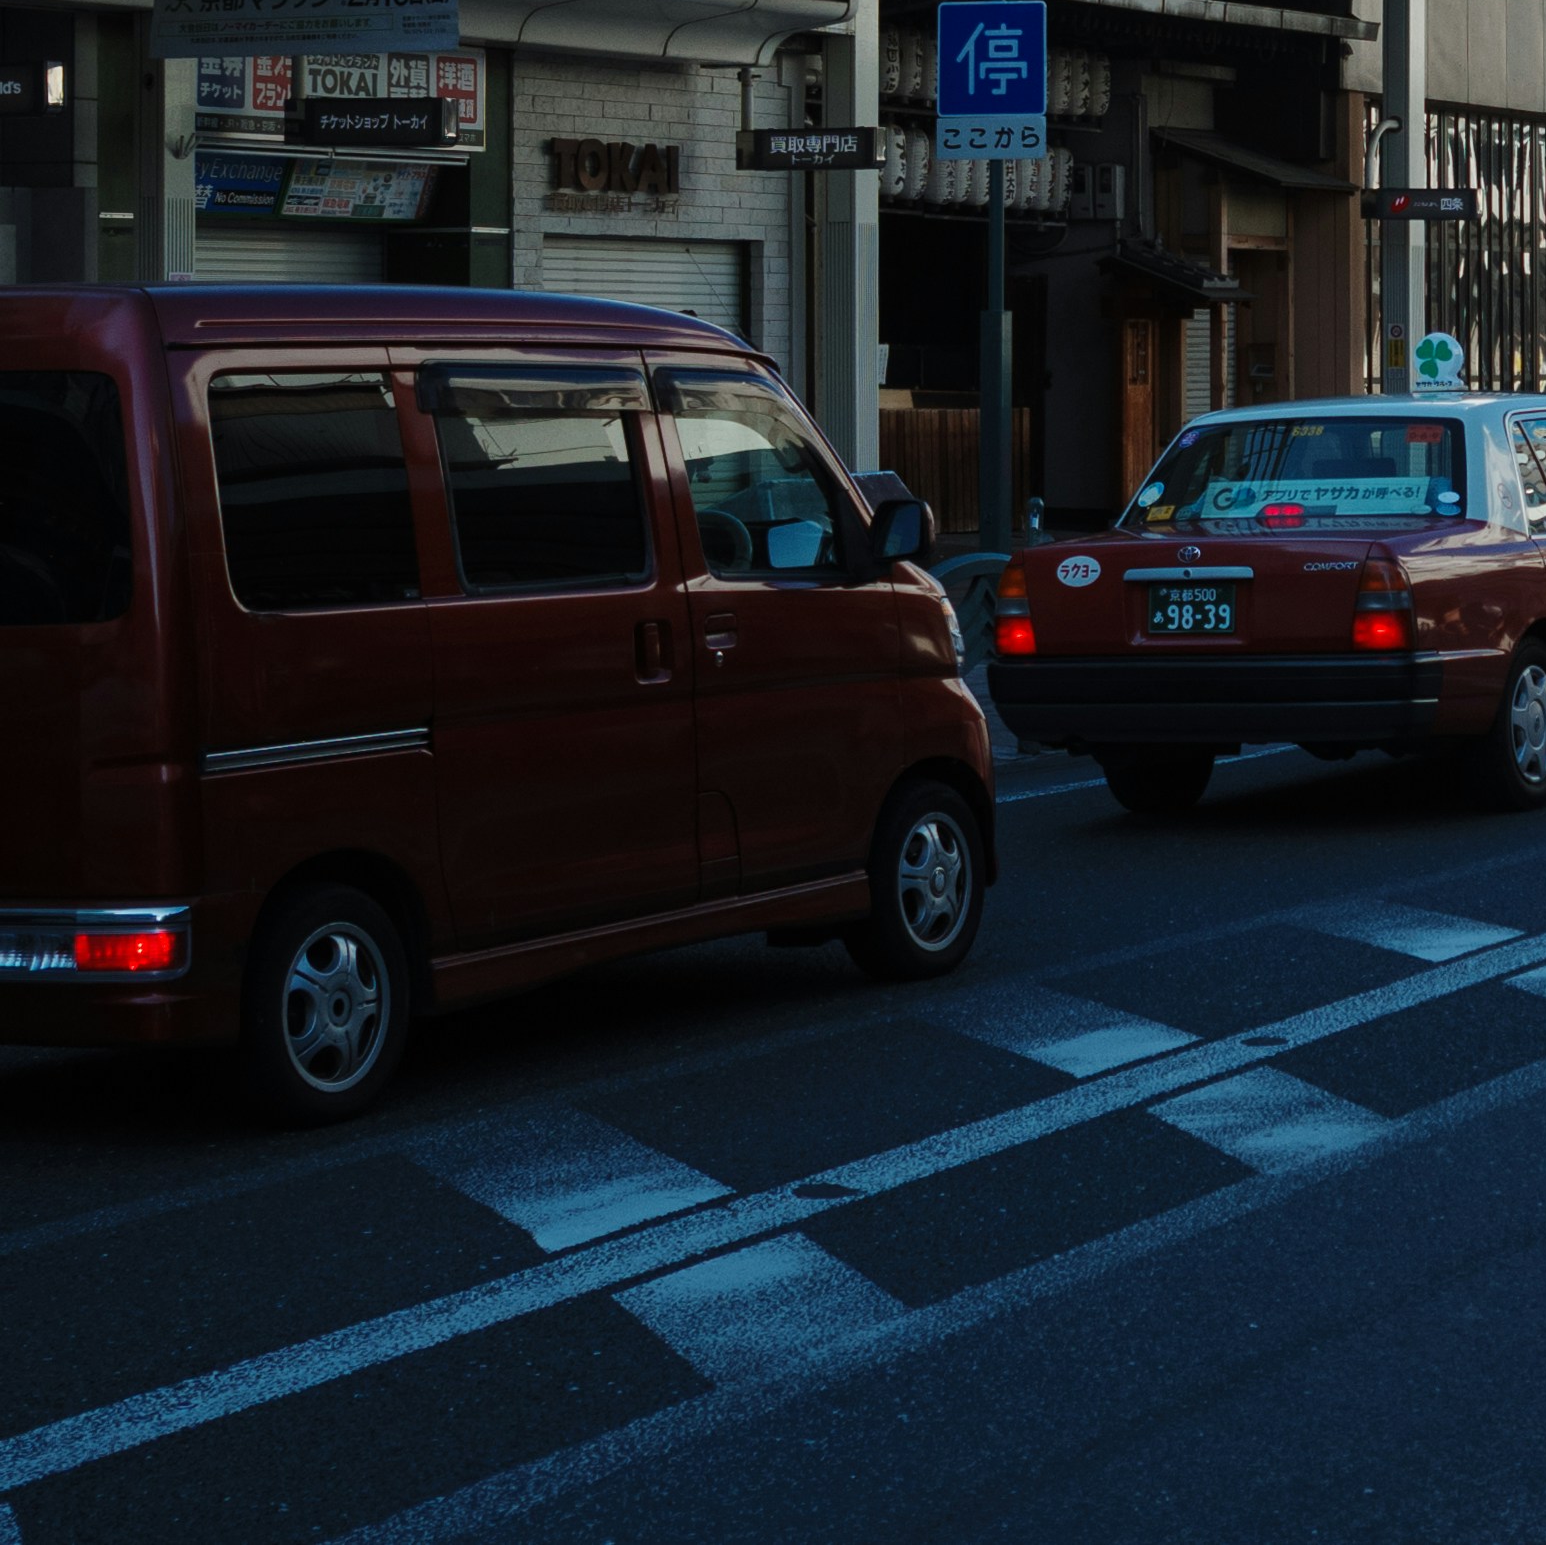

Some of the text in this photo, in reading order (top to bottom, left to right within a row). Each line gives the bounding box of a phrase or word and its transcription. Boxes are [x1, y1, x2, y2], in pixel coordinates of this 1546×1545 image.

[956, 22, 1028, 95] 停
[308, 68, 378, 97] TOKAI
[390, 58, 428, 88] 外貨
[439, 62, 475, 91] 洋酒
[200, 82, 243, 100] チケット
[319, 112, 429, 130] チケットショップ トーカイ
[770, 134, 859, 154] 買取専門店
[943, 126, 1040, 149] ここから
[550, 137, 680, 195] TOKAI
[791, 154, 836, 165] トーカイ
[209, 158, 284, 183] Exchange
[214, 191, 276, 206] No Commission
[1440, 197, 1465, 211] 四条
[1059, 563, 1099, 579] ラクヨー
[1303, 561, 1359, 571] COMFORT
[1167, 604, 1232, 630] 98-39
